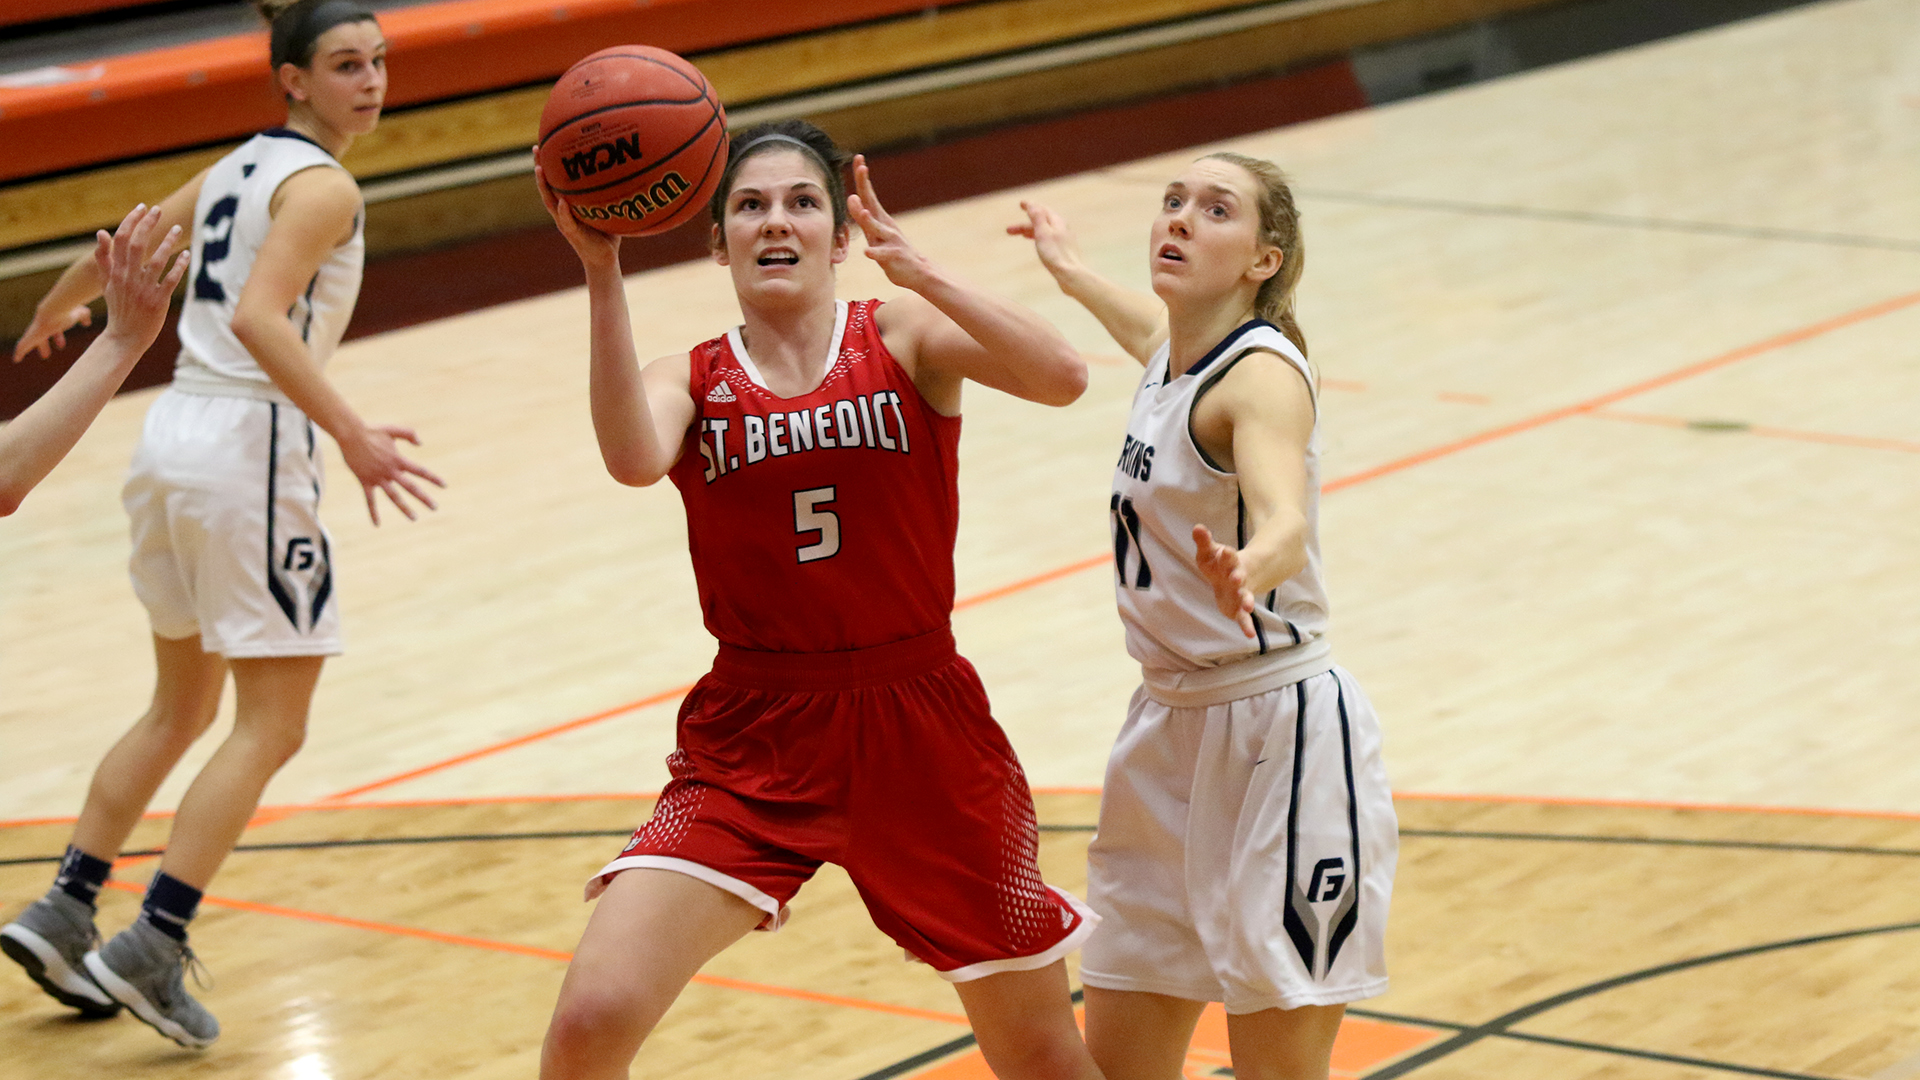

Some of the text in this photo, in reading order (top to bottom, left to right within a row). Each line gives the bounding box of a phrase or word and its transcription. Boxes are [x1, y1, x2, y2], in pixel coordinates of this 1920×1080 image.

[561, 132, 643, 182] NCAA
[571, 170, 692, 221] Wilson
[194, 193, 241, 304] 2
[706, 394, 737, 403] adidas
[743, 389, 910, 466] BENEDICT
[791, 484, 842, 565] 5
[1110, 491, 1152, 591] 11
